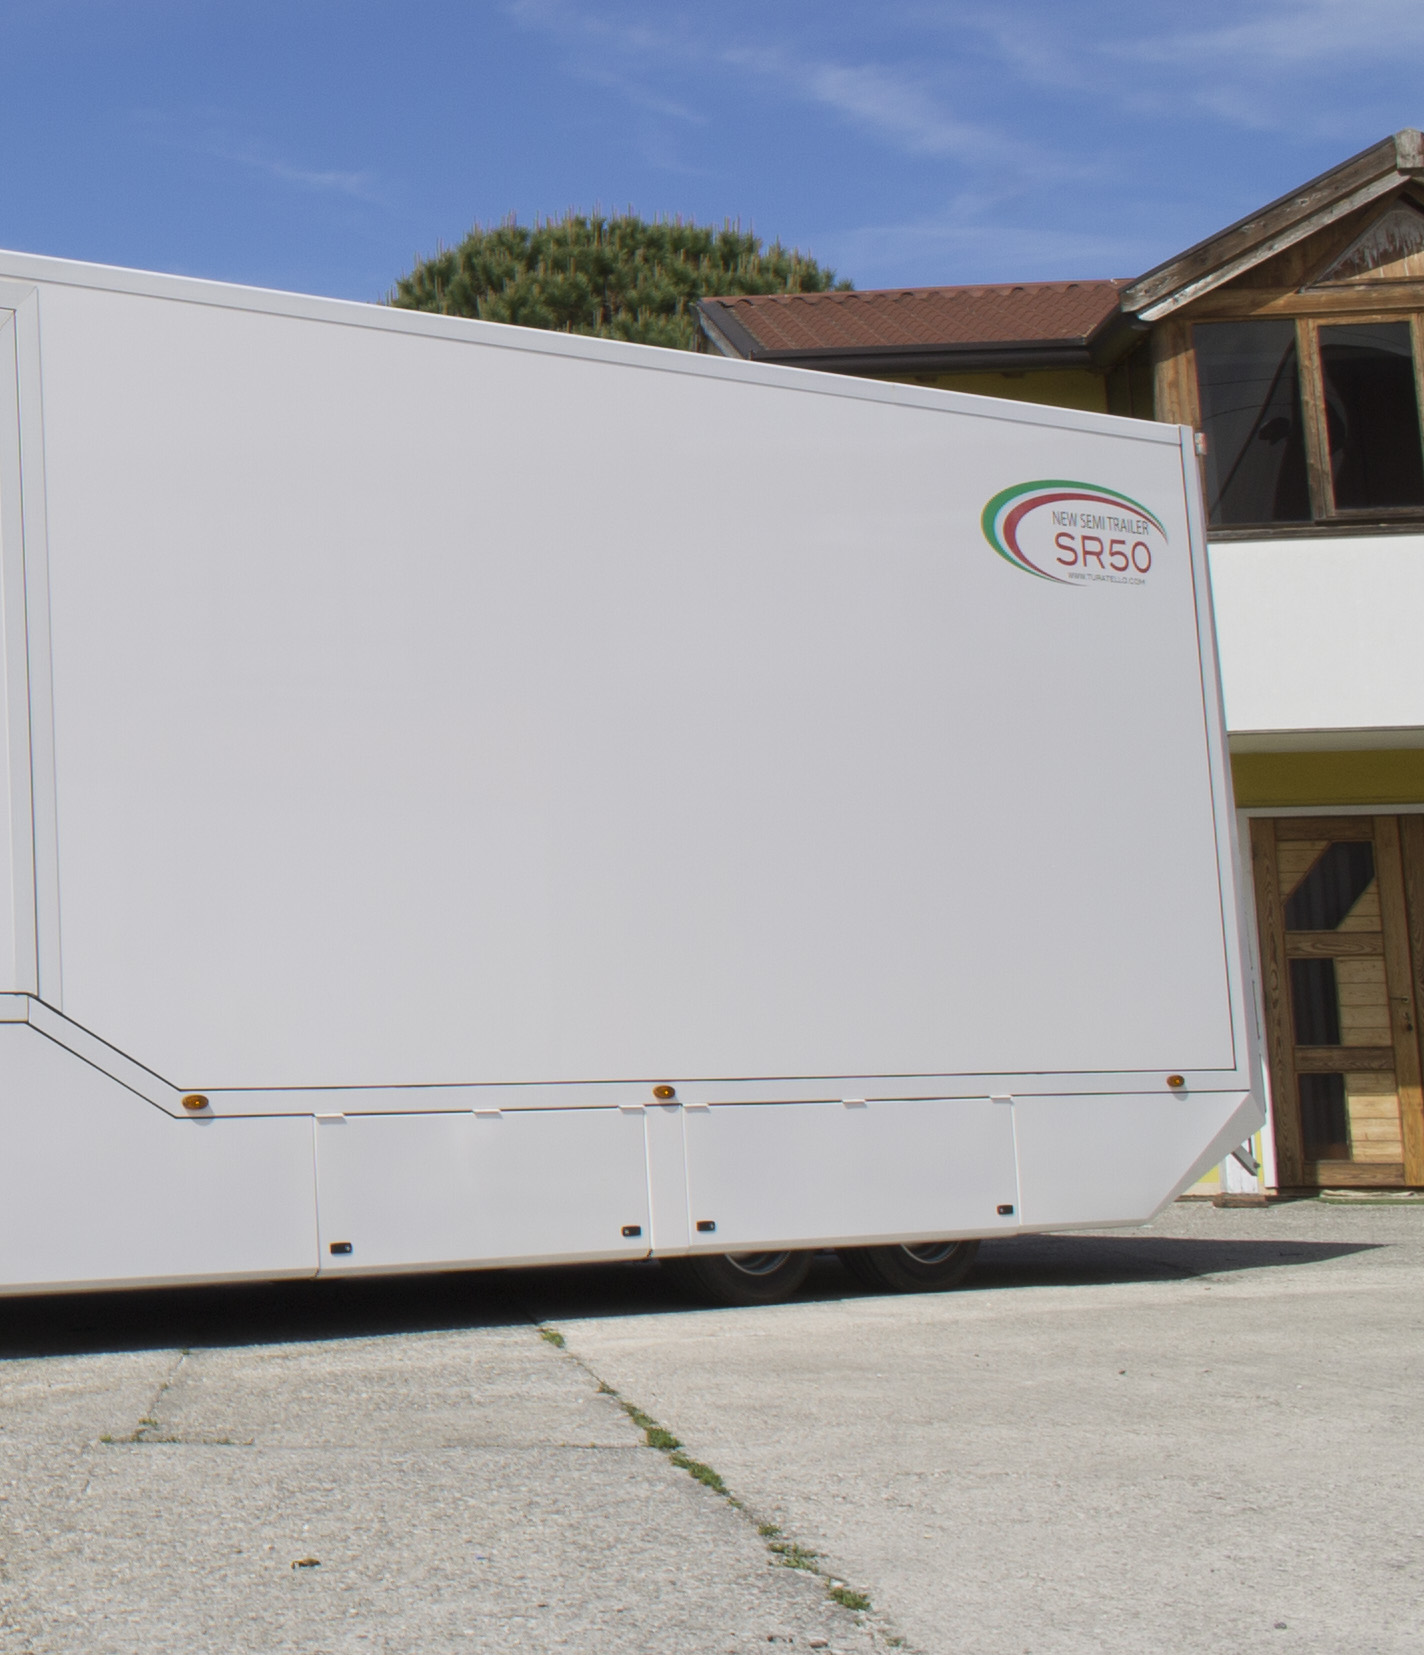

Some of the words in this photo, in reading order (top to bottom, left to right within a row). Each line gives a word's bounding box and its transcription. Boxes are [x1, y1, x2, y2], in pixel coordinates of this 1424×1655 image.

[1052, 510, 1077, 527] NEW
[1080, 513, 1105, 530] SEMI
[1106, 516, 1149, 536] TRAILER
[1054, 531, 1152, 574] SR50
